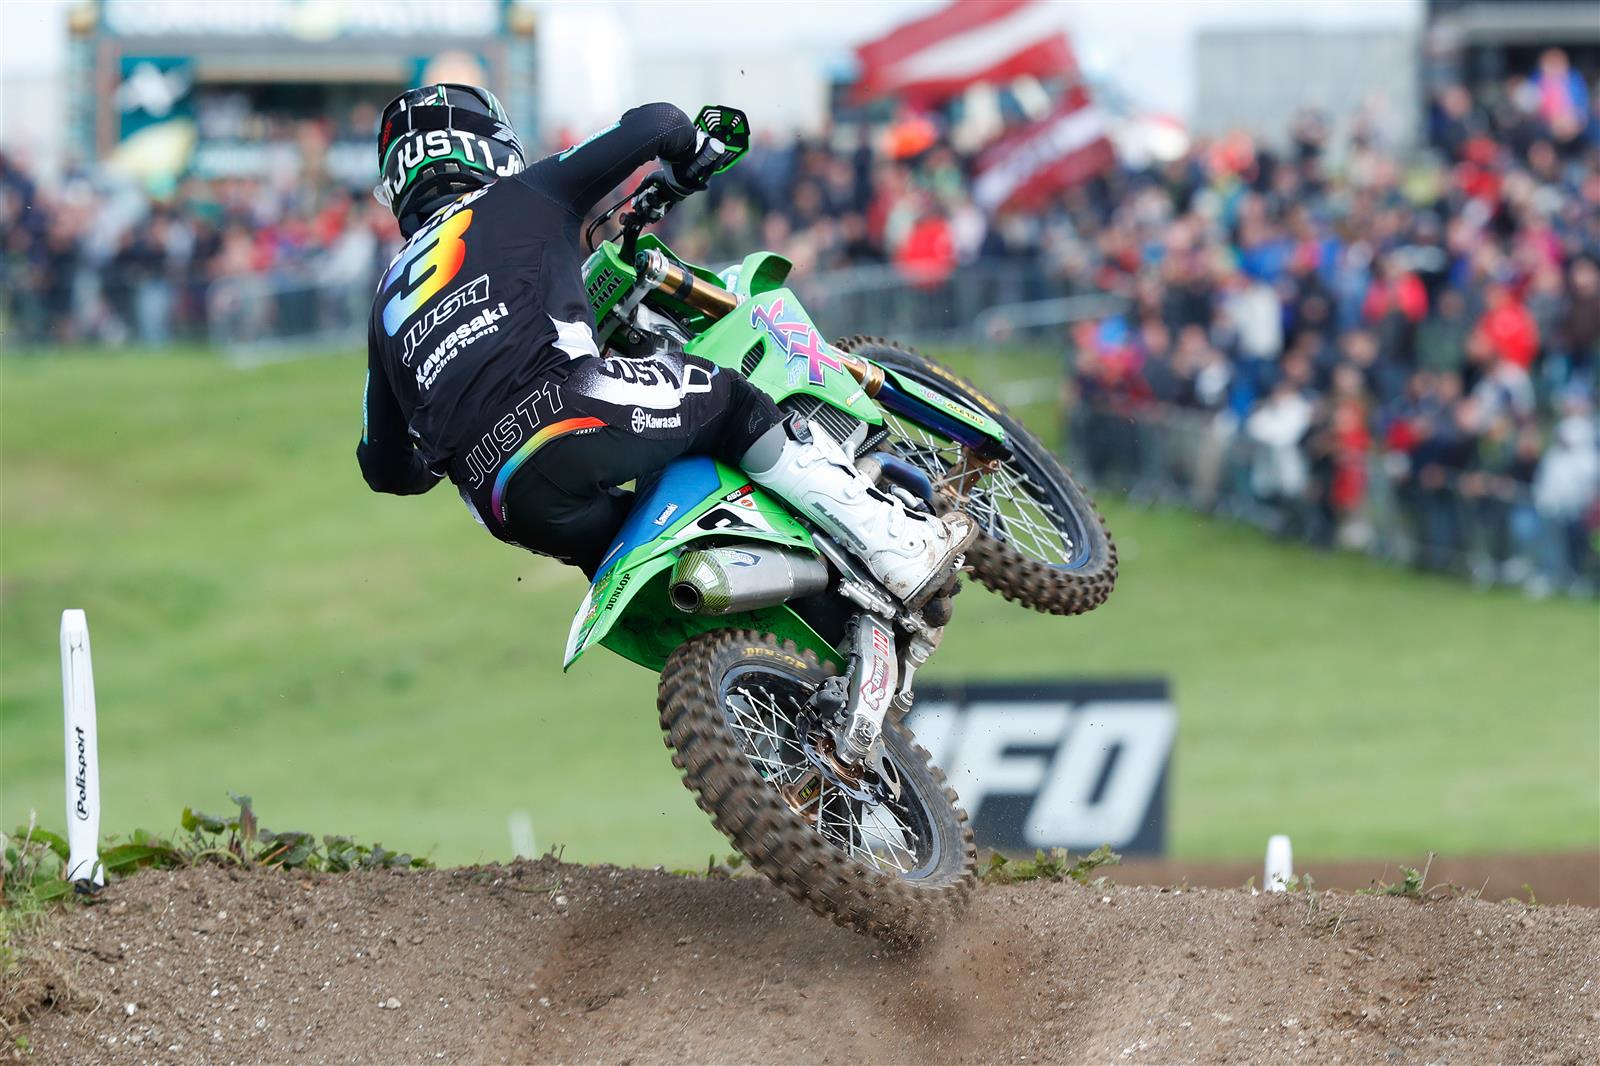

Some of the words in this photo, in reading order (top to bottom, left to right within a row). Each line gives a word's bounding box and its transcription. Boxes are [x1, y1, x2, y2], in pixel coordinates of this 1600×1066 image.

[393, 130, 495, 194] JUST1
[382, 208, 474, 337] 3
[592, 276, 625, 309] THAL
[402, 273, 490, 367] JUST1
[416, 302, 509, 391] Kawasaki
[424, 347, 458, 390] Racing
[457, 324, 499, 348] Team
[464, 381, 564, 490] JUST1
[605, 573, 632, 611] DUNLOP
[75, 726, 88, 820] Polisport
